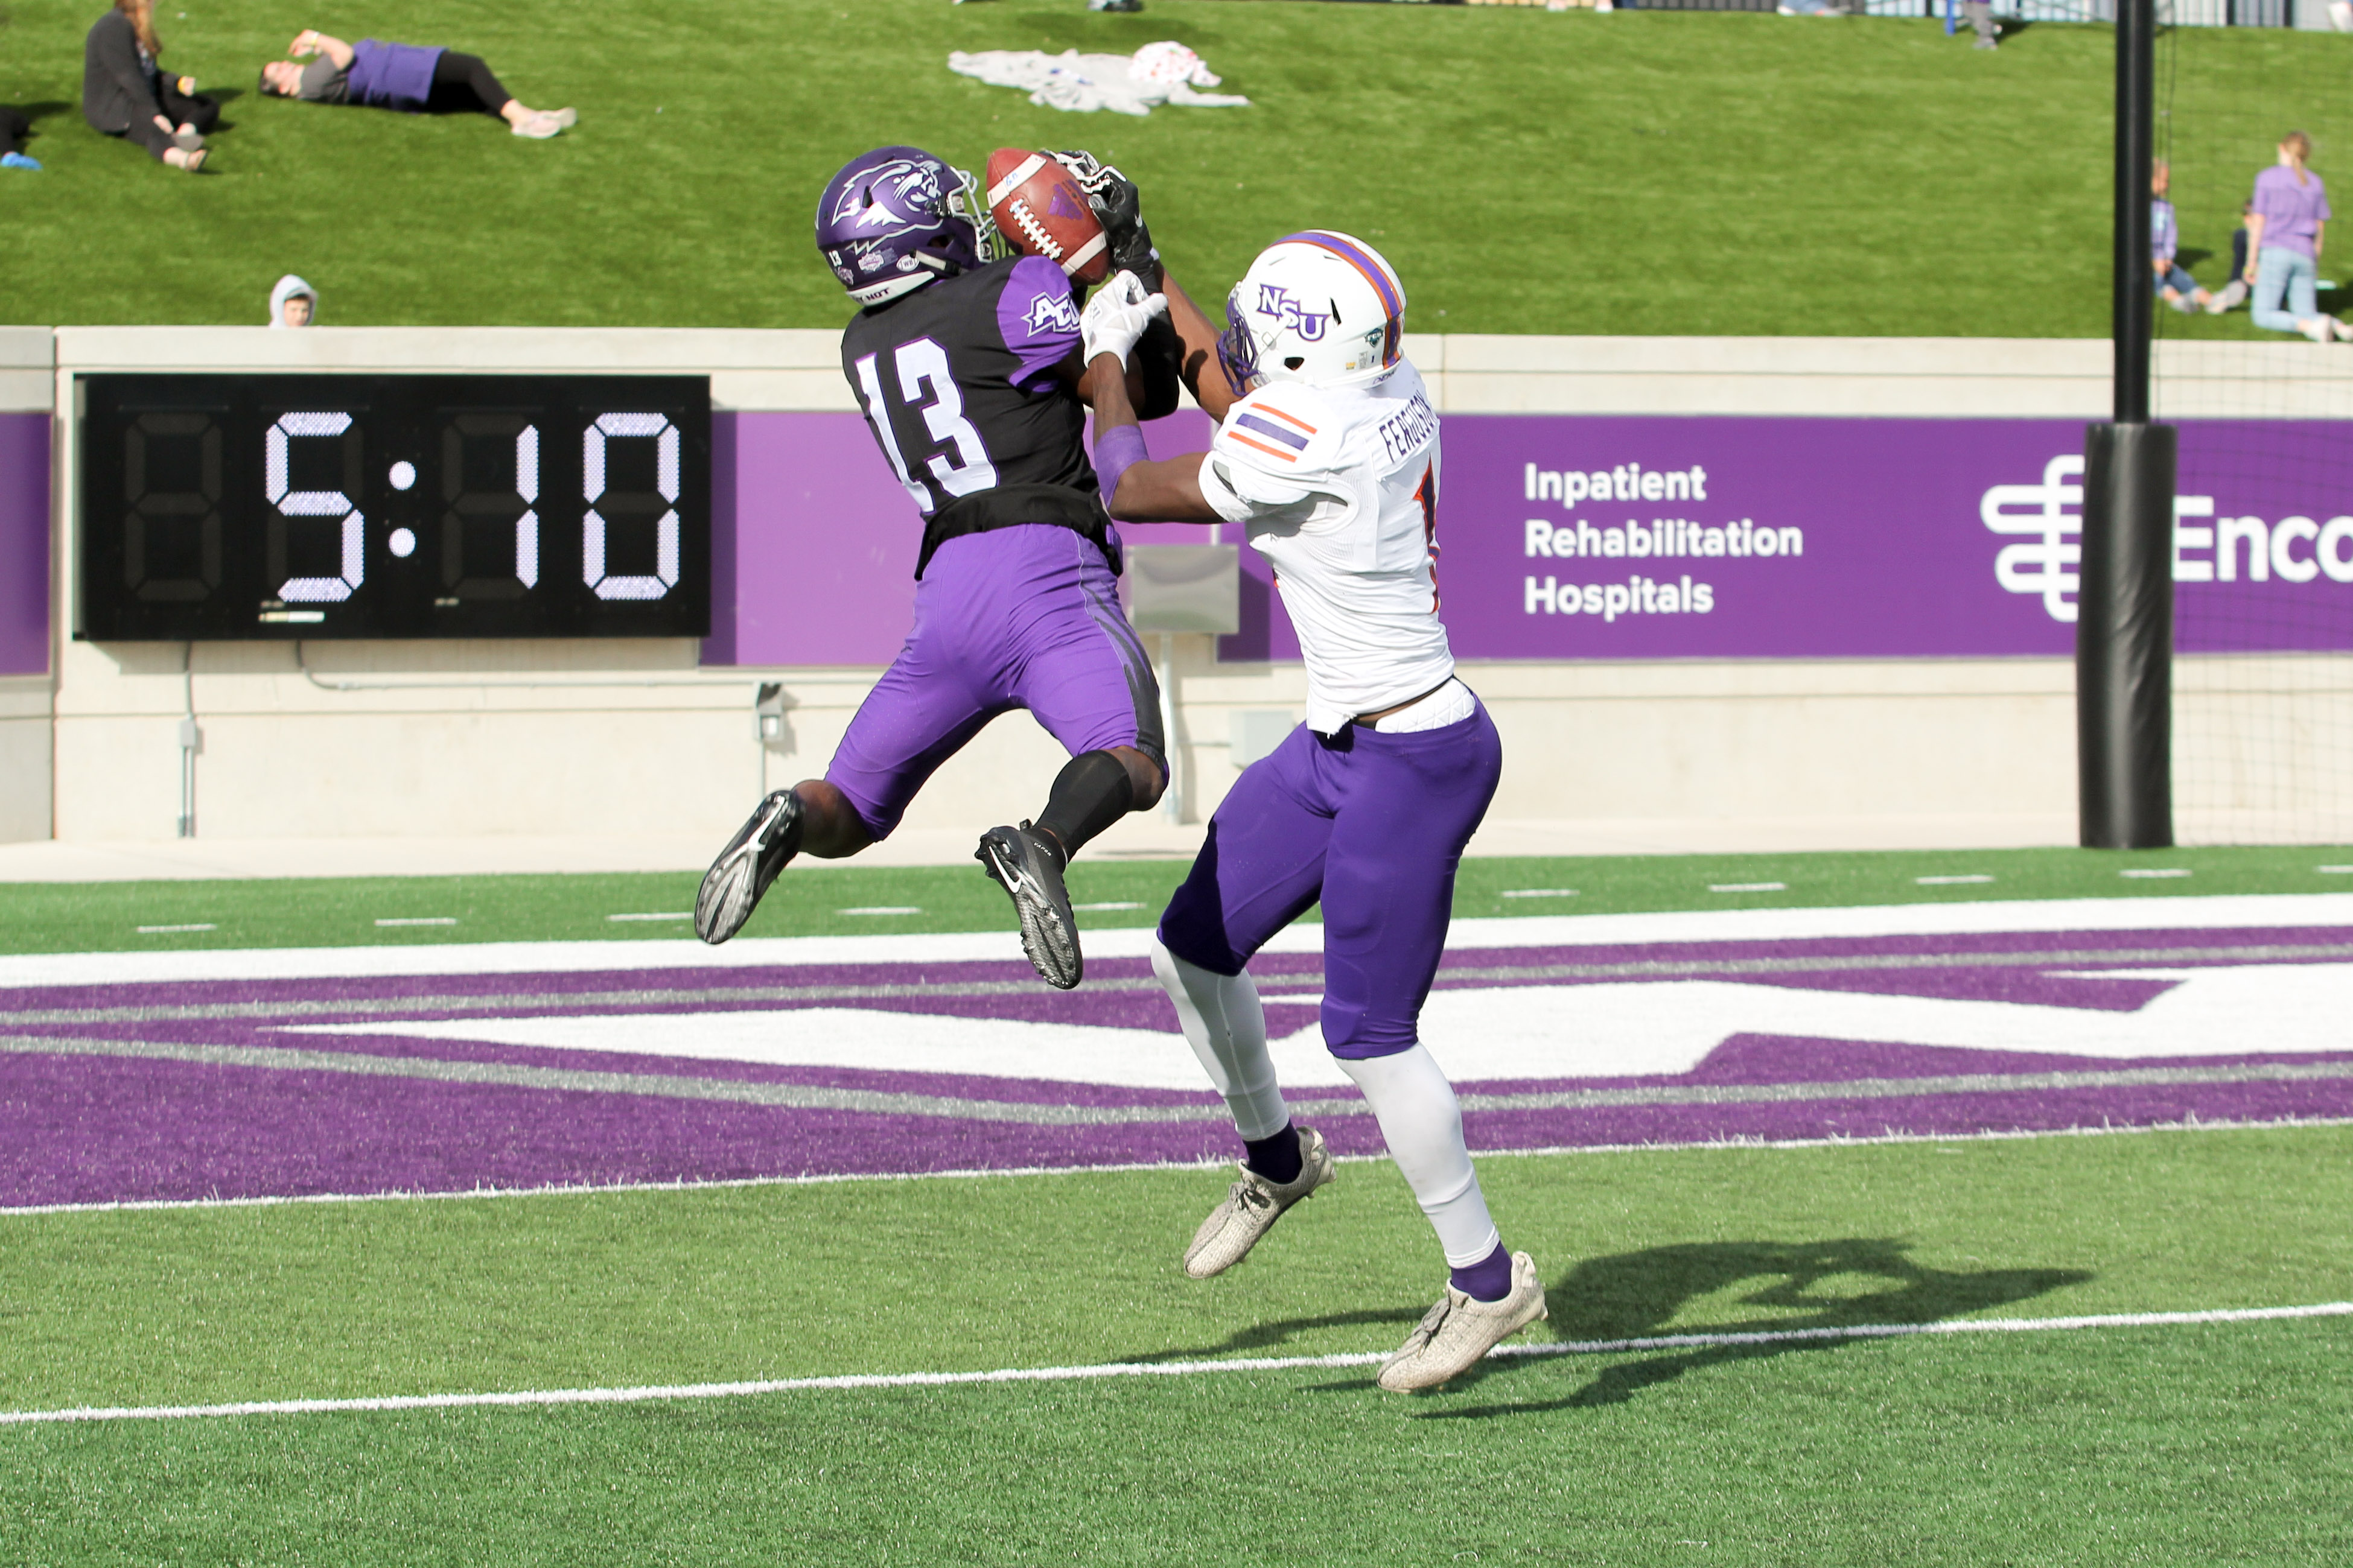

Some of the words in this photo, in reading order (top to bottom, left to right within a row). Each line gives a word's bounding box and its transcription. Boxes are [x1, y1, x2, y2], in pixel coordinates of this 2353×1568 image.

[829, 250, 842, 267] 13
[865, 287, 889, 300] NOT
[1032, 295, 1080, 329] ACU
[1256, 283, 1331, 342] NSU
[855, 335, 999, 514] 13
[1379, 389, 1436, 463] FERGUSON
[266, 412, 680, 601] 5:10
[1524, 462, 1707, 510] Inpatient
[1524, 518, 1804, 558] Rehabilitation
[2173, 495, 2353, 583] Enco
[1524, 574, 1715, 623] Hospitals
[1034, 842, 1052, 857] VAPOR
